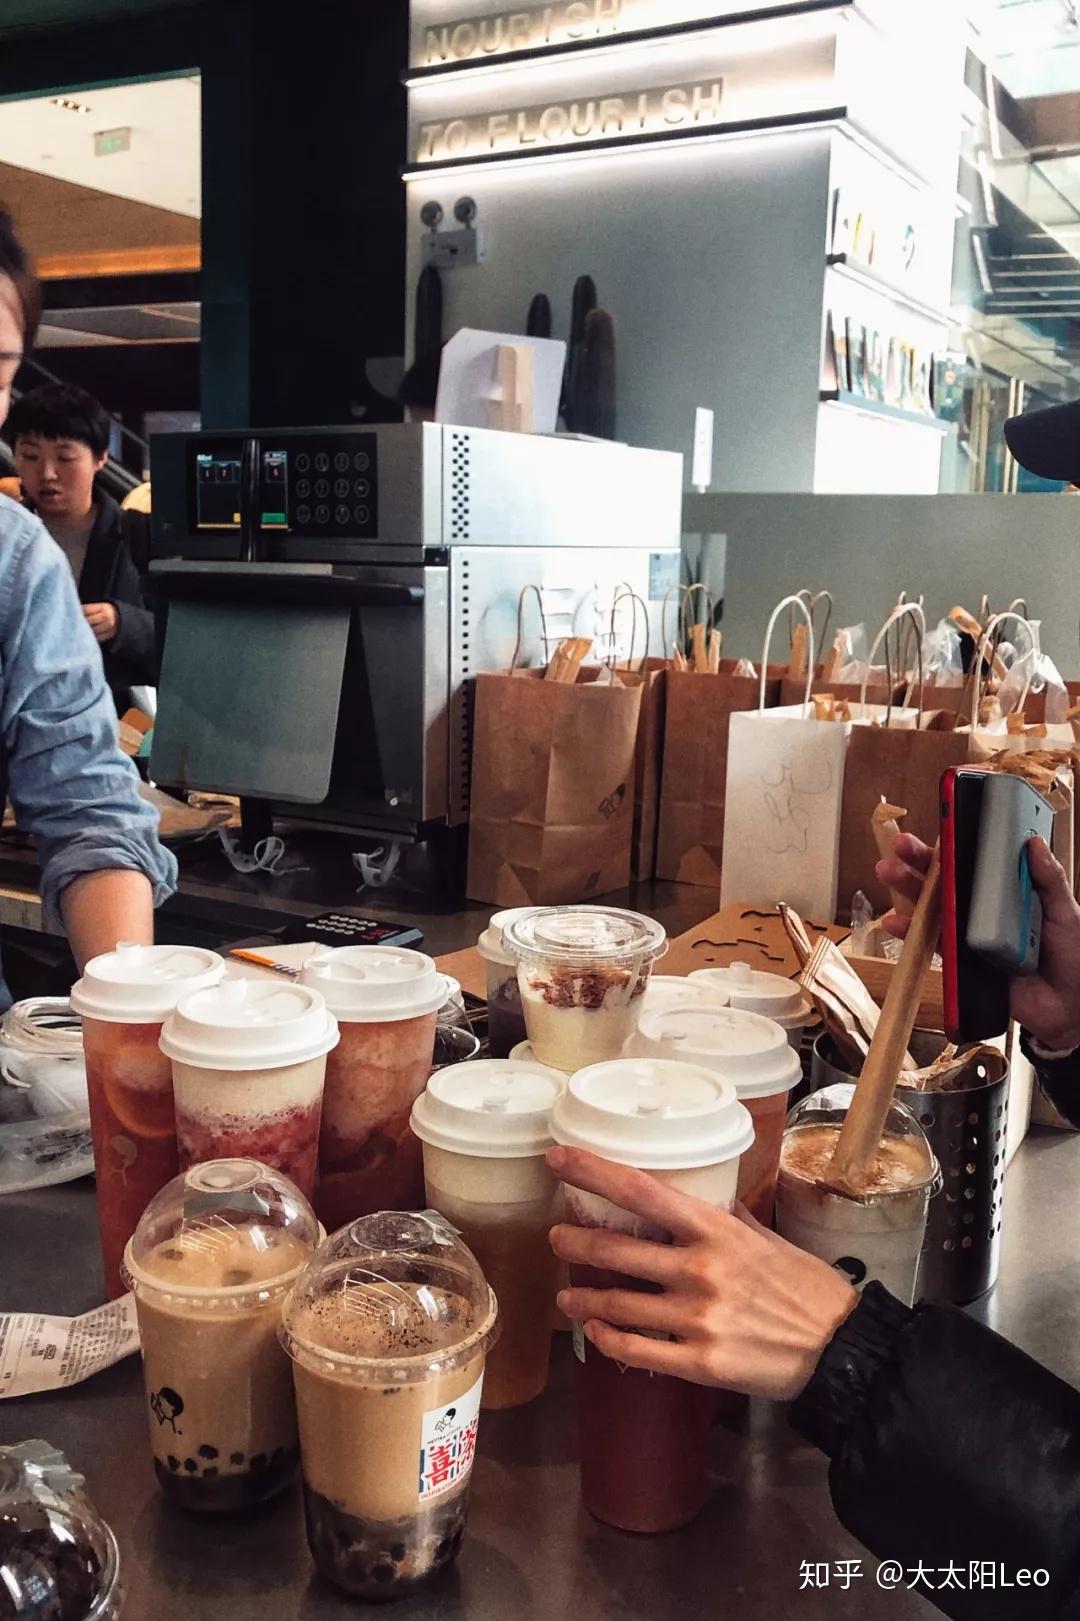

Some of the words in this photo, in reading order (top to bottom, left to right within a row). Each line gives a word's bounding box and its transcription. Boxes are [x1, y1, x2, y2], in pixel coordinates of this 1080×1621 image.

[425, 0, 621, 62] NOURISH
[420, 119, 469, 156] TO
[486, 83, 721, 148] FLOURISH
